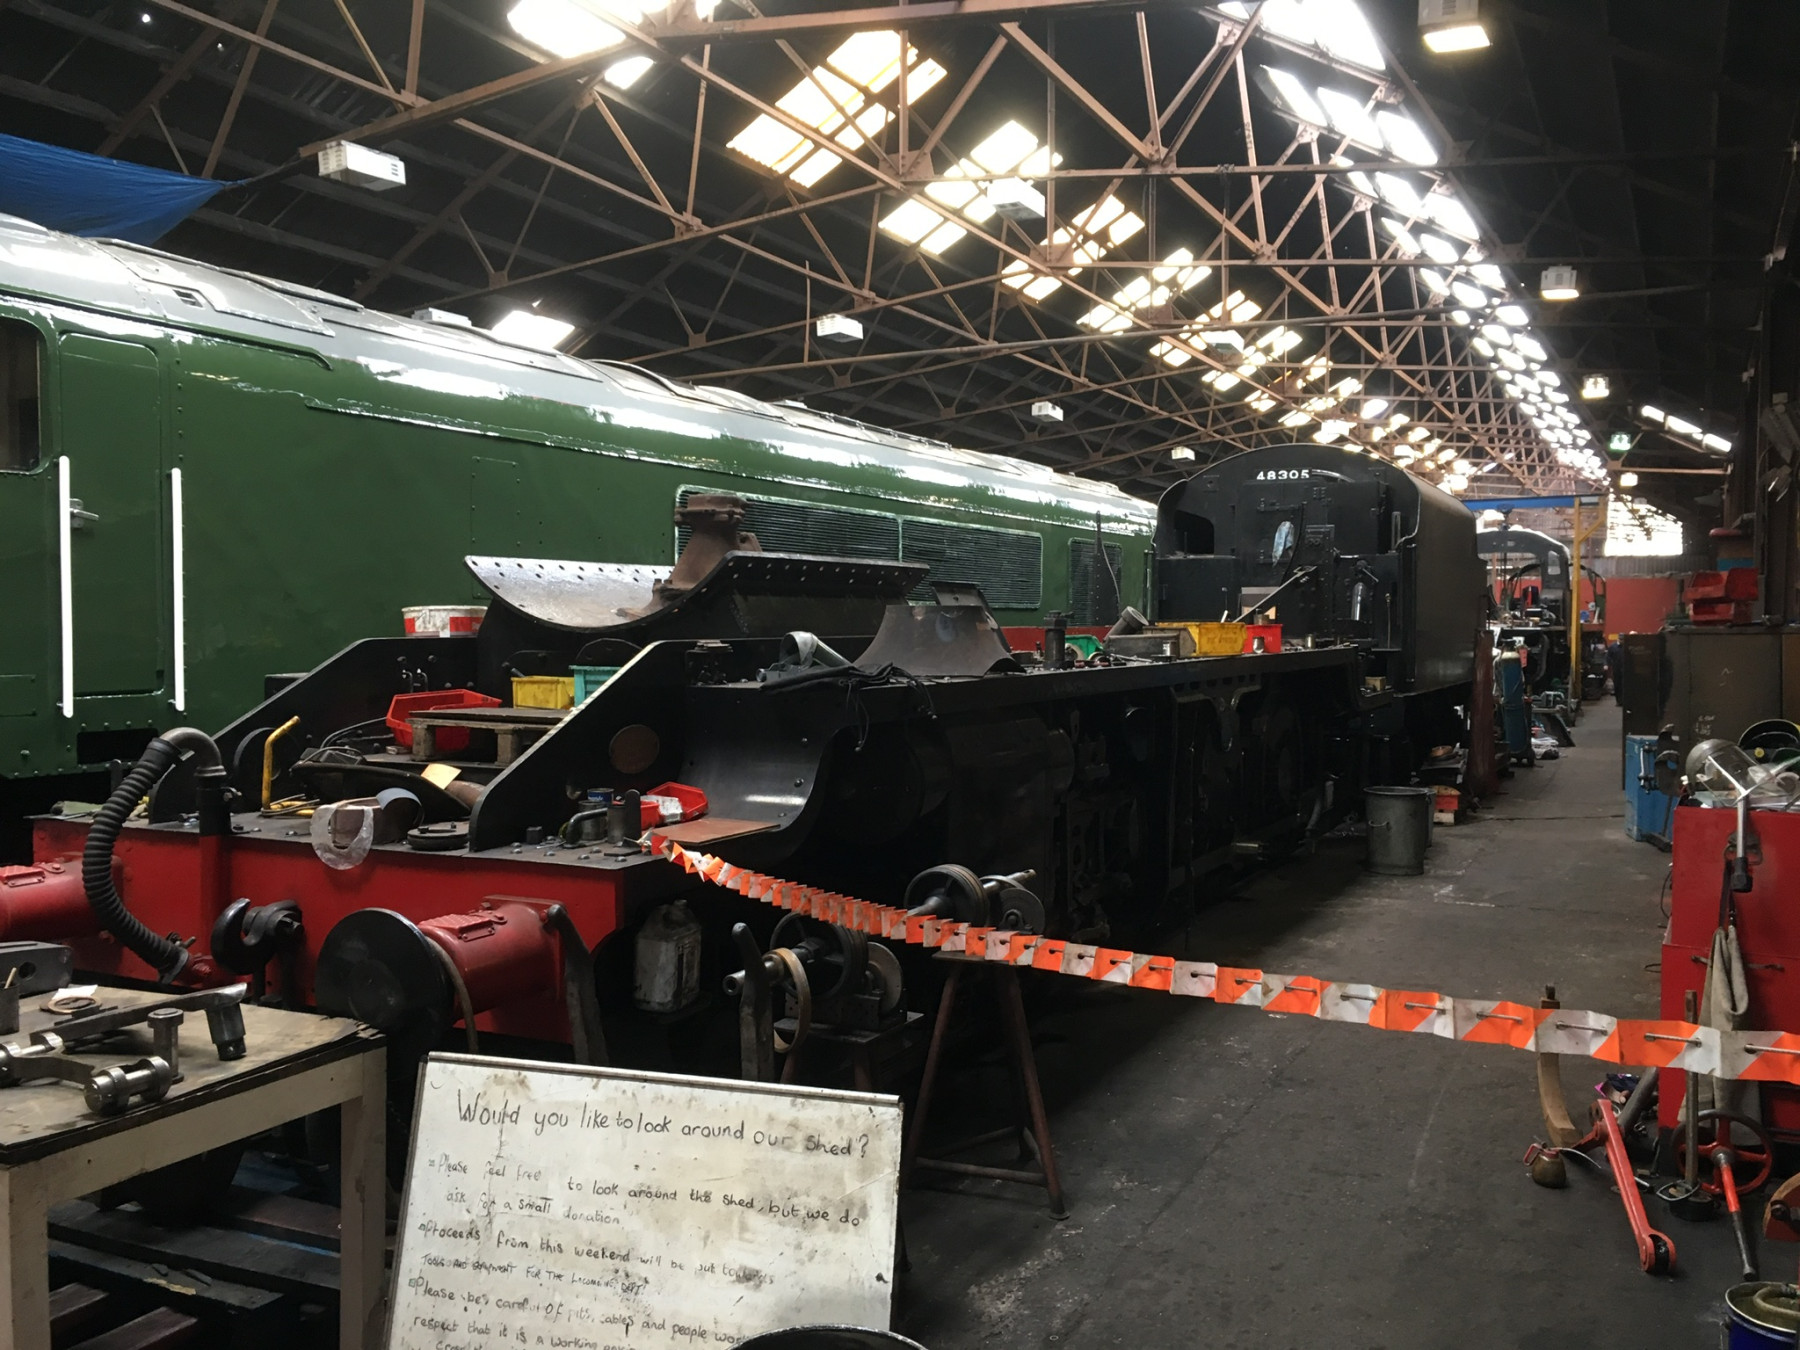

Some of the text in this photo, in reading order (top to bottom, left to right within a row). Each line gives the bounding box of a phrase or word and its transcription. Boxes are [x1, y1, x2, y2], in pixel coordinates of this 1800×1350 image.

[1256, 469, 1310, 480] 48305
[458, 1089, 521, 1125] Would
[534, 1111, 569, 1136] you
[580, 1101, 610, 1129] like
[616, 1111, 634, 1129] to
[637, 1112, 672, 1133] look
[681, 1120, 745, 1141] around
[753, 1130, 793, 1147] our
[446, 1191, 467, 1204] ask
[503, 1201, 513, 1211] a
[567, 1176, 583, 1191] to
[592, 1179, 619, 1196] look
[627, 1188, 678, 1201] around
[689, 1188, 713, 1203] the
[768, 1200, 800, 1218] but
[806, 1209, 830, 1222] we
[839, 1208, 861, 1227] do
[539, 1237, 565, 1254] this
[574, 1246, 631, 1263] weekend
[639, 1254, 662, 1268] will
[670, 1259, 685, 1271] be
[414, 1275, 456, 1301] Please
[641, 1317, 666, 1331] and
[671, 1323, 708, 1344] people
[413, 1316, 460, 1332] respect
[467, 1321, 491, 1336] that
[499, 1322, 508, 1338] it
[515, 1326, 528, 1345] is
